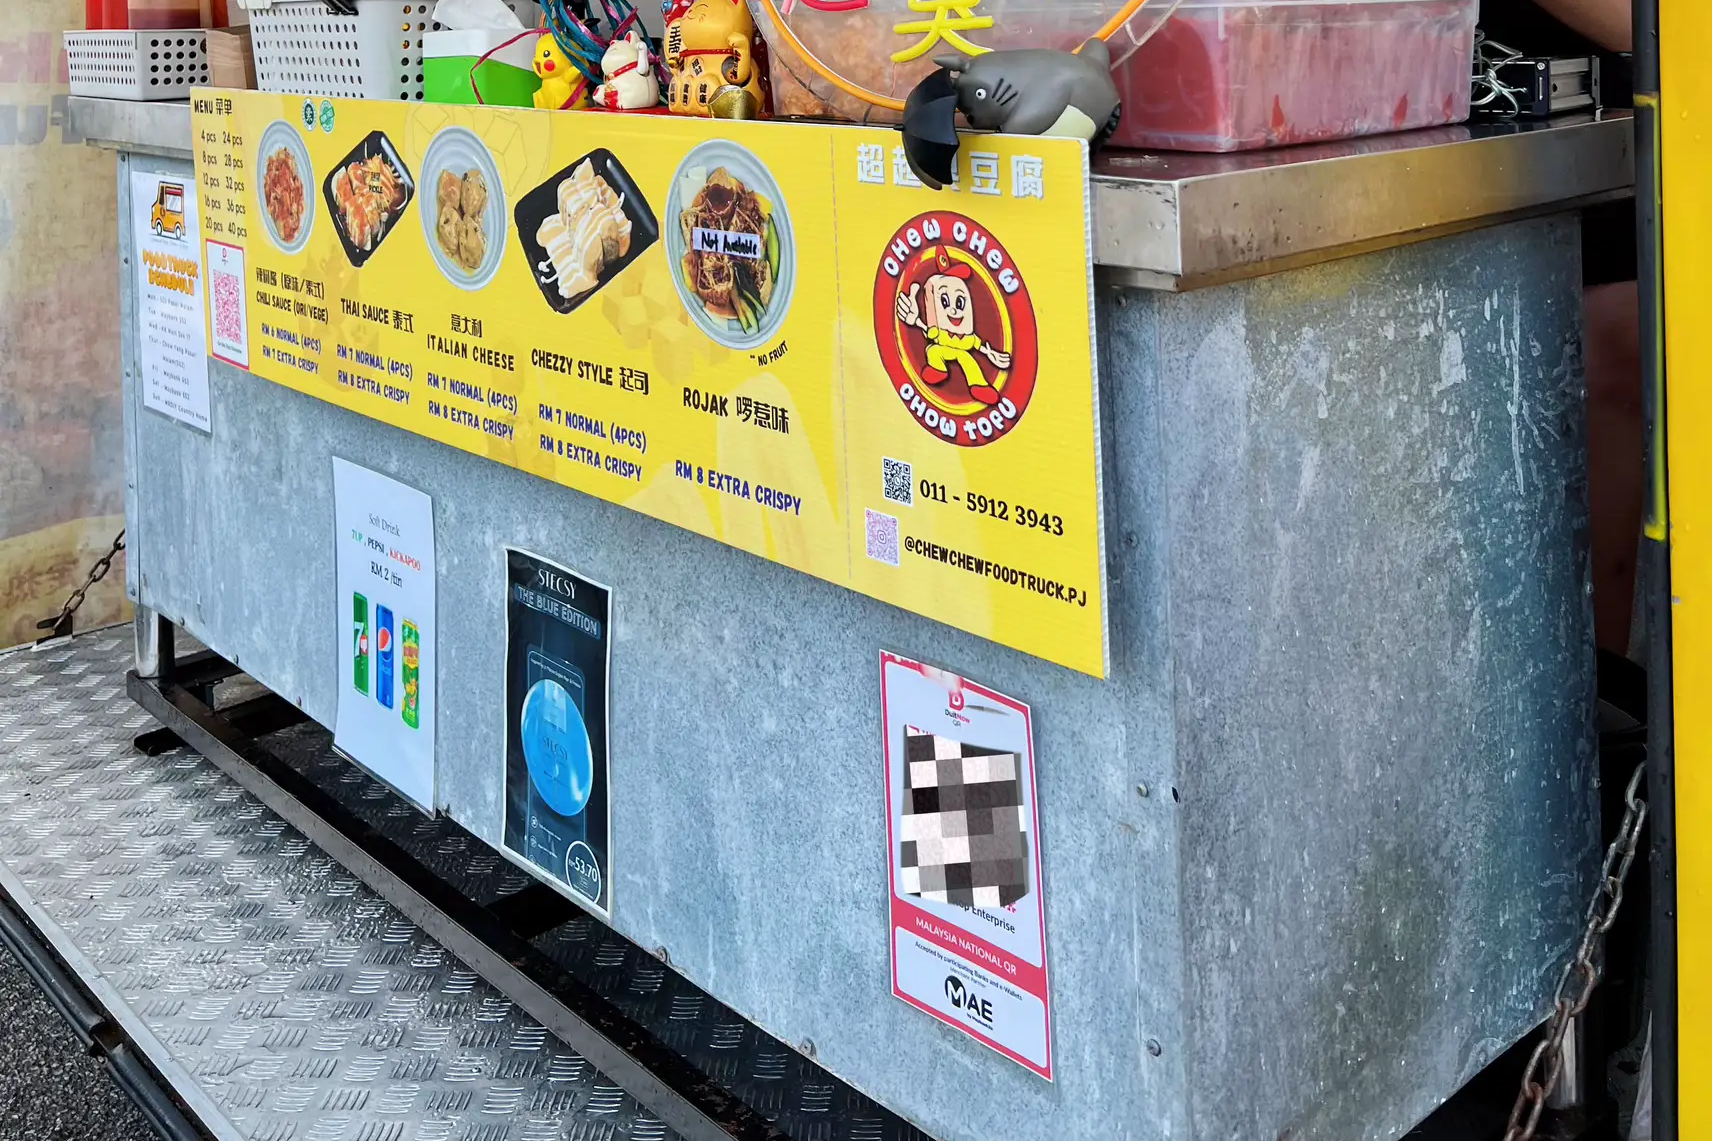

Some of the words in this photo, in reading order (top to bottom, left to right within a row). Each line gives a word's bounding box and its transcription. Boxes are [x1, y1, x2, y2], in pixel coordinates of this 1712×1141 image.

[194, 99, 213, 114] MENU
[216, 98, 232, 115] 菜单
[201, 130, 205, 140] 4
[206, 132, 216, 146] pcs
[223, 131, 230, 144] 24
[232, 135, 242, 148] pcs
[203, 151, 206, 163] 8
[207, 154, 217, 167] pcs
[224, 154, 231, 167] 28
[233, 157, 243, 171] pcs
[857, 142, 1044, 199] 超超豆腐
[203, 172, 209, 186] 12
[210, 175, 219, 190] pcs
[226, 176, 233, 190] 32
[234, 180, 244, 193] pcs
[204, 194, 210, 207] 16
[212, 197, 221, 212] pcs
[227, 198, 234, 212] 36
[235, 203, 246, 216] pcs
[206, 216, 212, 229] 20
[214, 220, 223, 234] pcs
[228, 221, 235, 236] 40
[237, 226, 247, 238] pcs
[702, 232, 719, 252] Not
[272, 295, 292, 312] SAUCE
[341, 298, 360, 318] THAI
[363, 306, 389, 324] SAUCE
[262, 322, 269, 335] RM
[276, 327, 299, 345] NORMAL
[301, 334, 321, 355] (4PCS)
[450, 313, 482, 338] 意大利
[263, 345, 270, 358] RM
[272, 348, 275, 359] 7
[277, 350, 296, 367] EXTRA
[298, 358, 318, 374] CRISPY
[337, 344, 347, 359] RM
[349, 348, 353, 361] 7
[356, 349, 385, 370] NORMAL
[388, 357, 413, 382] (4PCS)
[427, 334, 468, 358] ITALIAN
[473, 346, 514, 371] CHEESE
[758, 355, 768, 366] NO
[769, 340, 788, 363] FRUIT
[338, 370, 348, 385] RM
[357, 376, 381, 396] EXTRA
[384, 385, 410, 405] CRISPY
[531, 348, 572, 376] CHEZZY
[578, 360, 613, 386] STYLE
[619, 366, 649, 395] 起司
[428, 372, 439, 389] RM
[442, 377, 446, 390] 7
[450, 379, 484, 402] NORMAL
[488, 388, 518, 416] (4PCS)
[683, 387, 728, 417] ROJAK
[429, 400, 440, 416] RM
[443, 405, 448, 419] 8
[451, 407, 480, 430] EXTRA
[483, 418, 513, 440] CRISPY
[539, 403, 552, 422] RM
[556, 409, 561, 424] 7
[565, 411, 606, 438] NORMAL
[610, 422, 646, 454] (4PCS)
[540, 434, 554, 453] RM
[558, 440, 563, 455] 8
[567, 442, 601, 468] EXTRA
[605, 455, 642, 482] CRISPY
[676, 460, 692, 480] RM
[697, 466, 703, 483] 8
[708, 470, 750, 500] EXTRA
[755, 484, 801, 516] CRISPY
[920, 479, 948, 504] 011
[966, 492, 1009, 521] 5912
[1015, 506, 1064, 536] 3943
[382, 519, 400, 536] Drink
[368, 537, 384, 553] PEPSI
[390, 547, 420, 571] KICKAPOO
[371, 561, 383, 578] RM
[384, 568, 389, 581] 2
[538, 569, 576, 599] STECSY
[904, 536, 1087, 607] @CHEWCHEWFOODTRUCK.PJ
[518, 586, 534, 605] THE
[536, 595, 559, 617] BLUE
[561, 608, 597, 635] EDITION
[972, 906, 1015, 934] Enterprise
[916, 917, 957, 944] MALAYSIA
[959, 938, 1002, 968] NATIONAL
[1004, 961, 1017, 975] QR
[915, 941, 936, 957] Accepted
[937, 952, 943, 960] by
[944, 956, 973, 975] participating
[974, 970, 988, 982] Banks
[990, 978, 998, 988] and
[945, 975, 993, 1022] MAE
